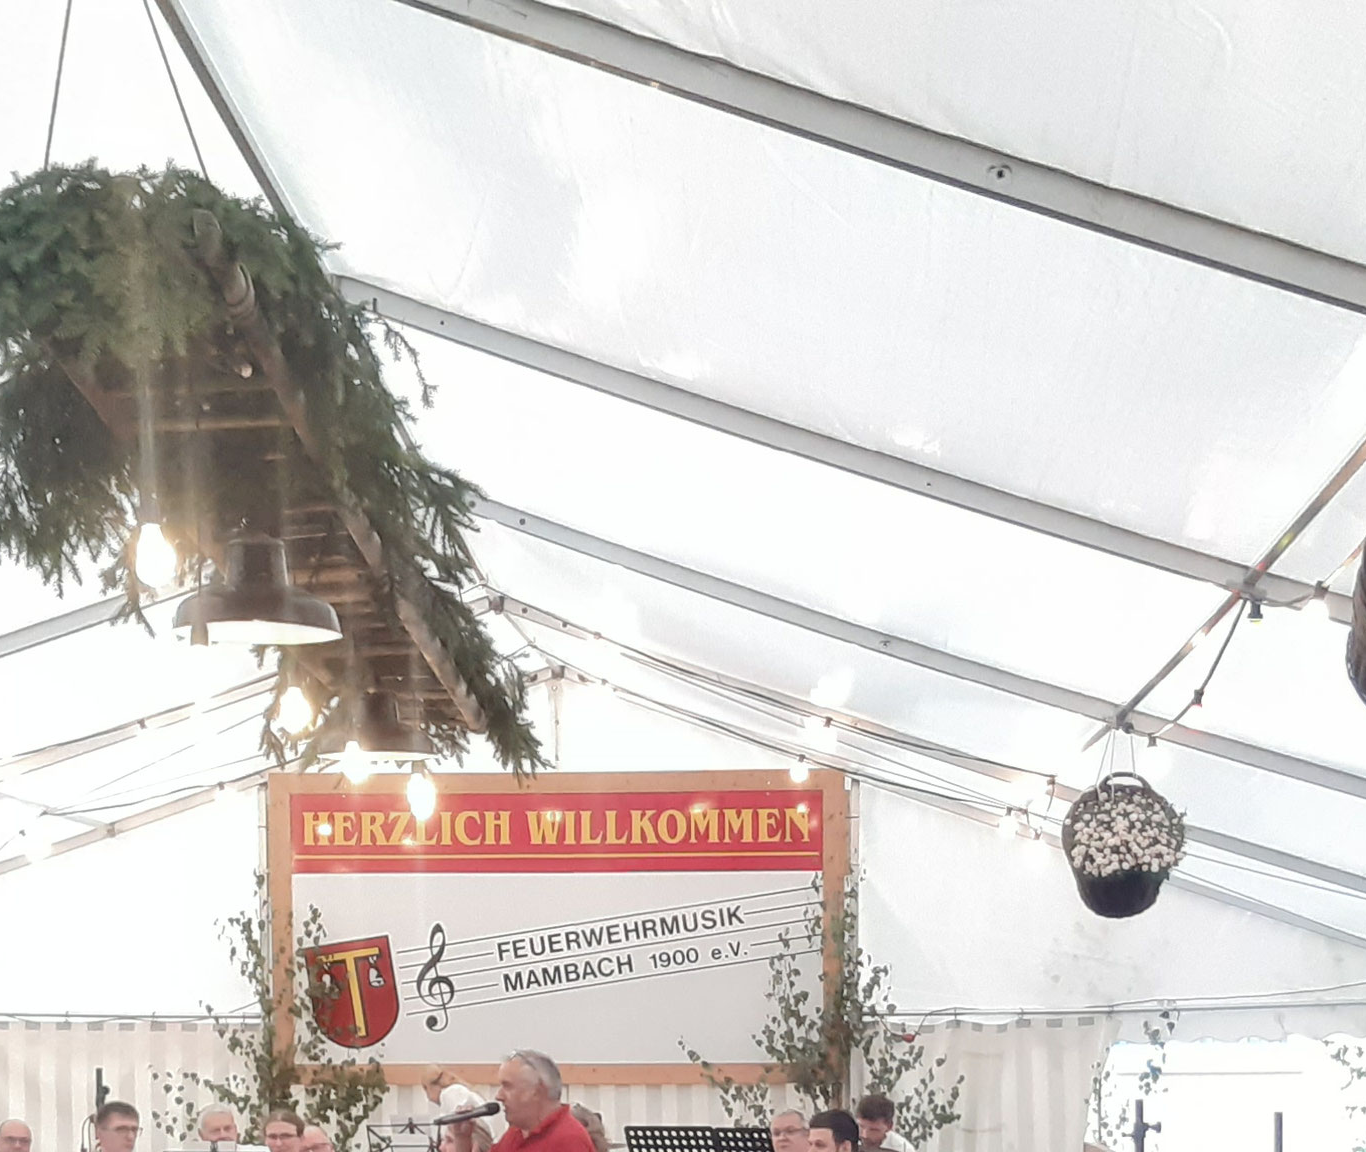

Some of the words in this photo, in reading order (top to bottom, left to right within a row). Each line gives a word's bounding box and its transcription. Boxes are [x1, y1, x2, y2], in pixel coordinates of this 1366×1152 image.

[302, 811, 512, 846] HERZLICH
[525, 808, 810, 845] WILLKOMMEN
[496, 905, 745, 961] FEUERWEHRMUSIK
[502, 954, 634, 993] MAMBACH
[648, 947, 699, 969] 1900
[710, 941, 748, 961] e.V.
